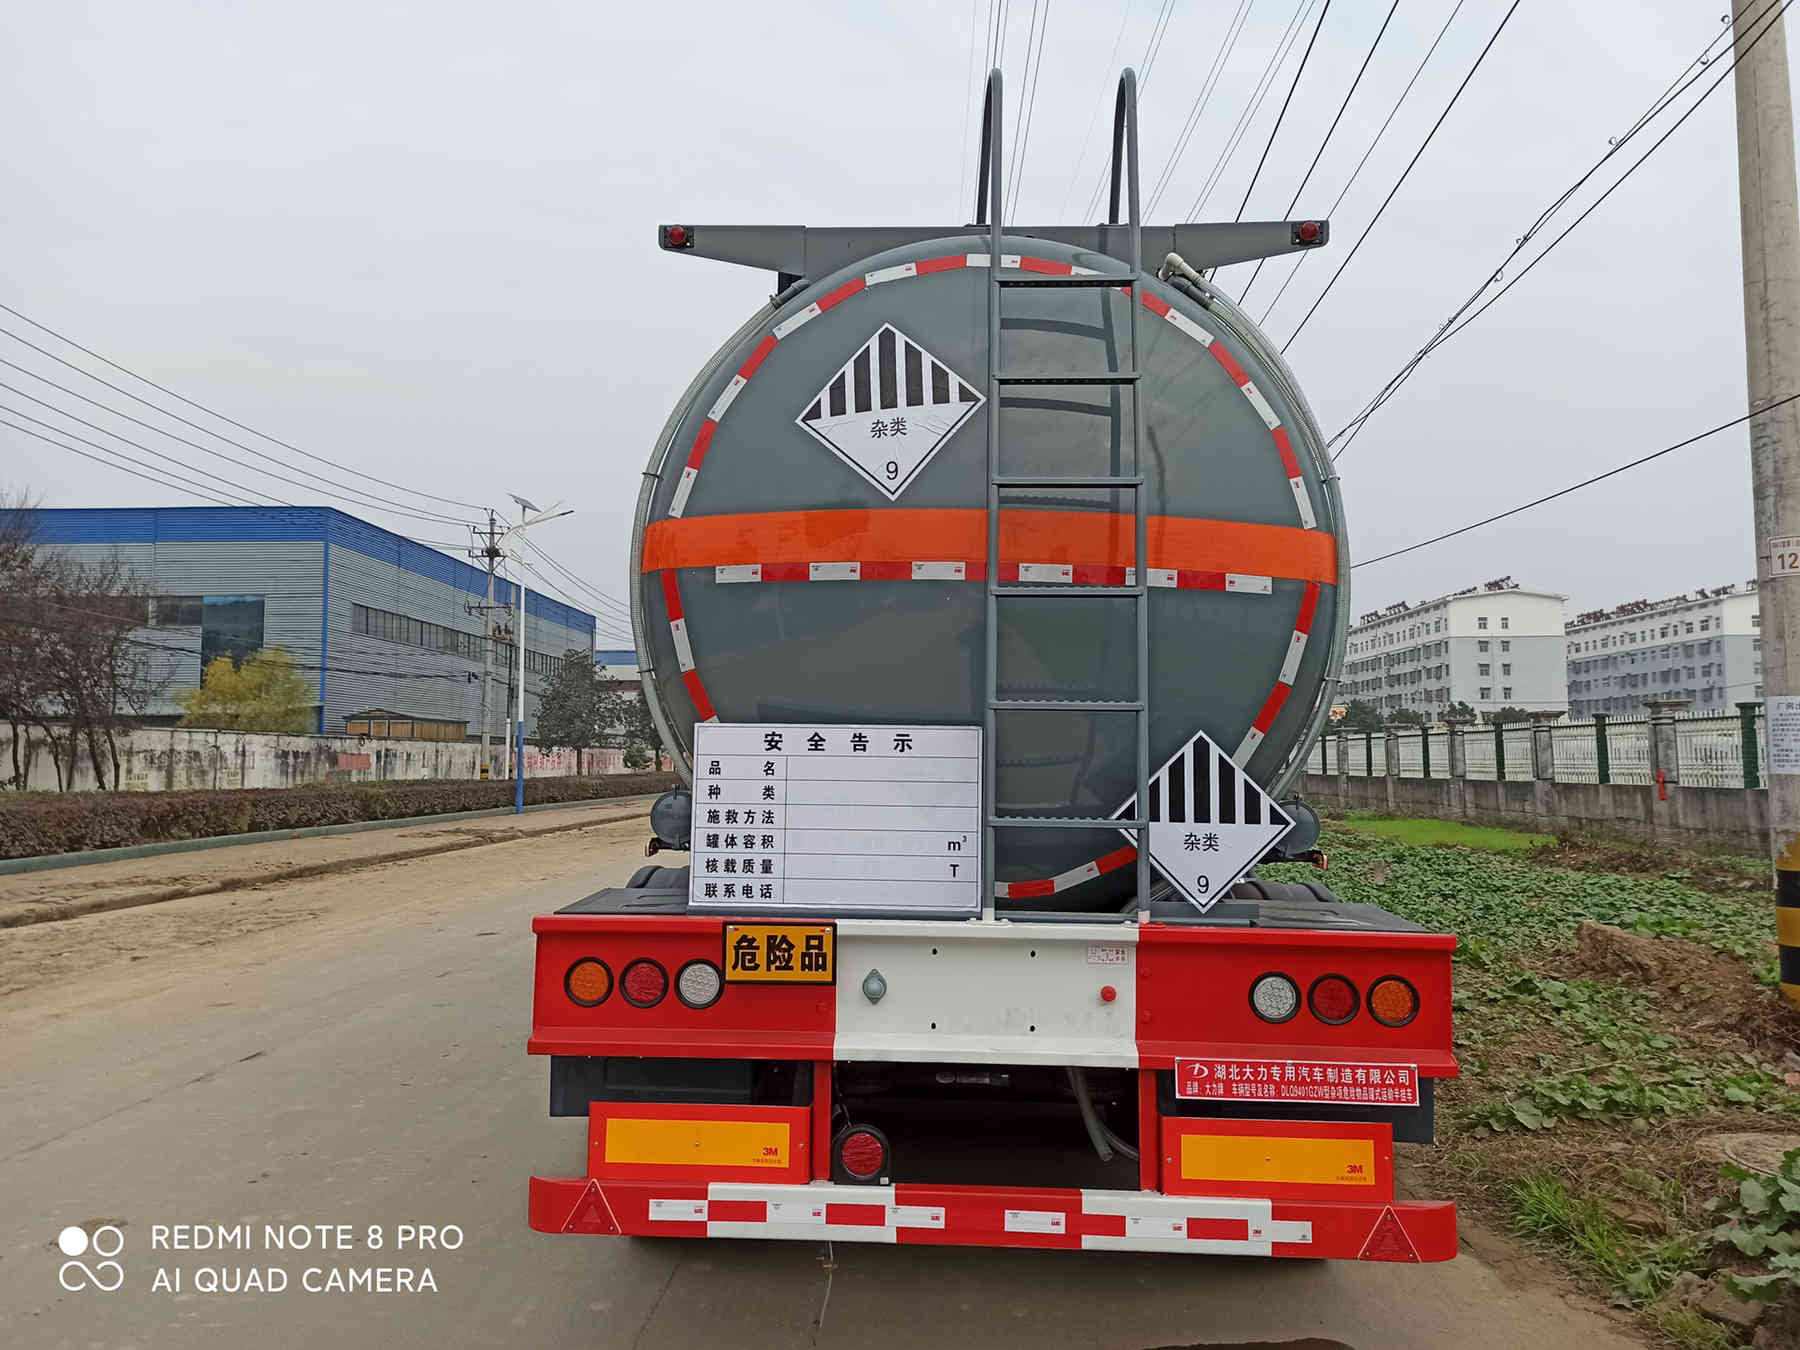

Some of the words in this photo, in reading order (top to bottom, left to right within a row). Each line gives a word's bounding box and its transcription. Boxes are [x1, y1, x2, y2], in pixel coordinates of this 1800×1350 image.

[870, 417, 908, 439] 杂类
[886, 461, 898, 480] 9
[764, 731, 913, 752] 安全告示
[706, 808, 775, 825] 施救方法
[706, 833, 775, 850] 罐体容积
[1184, 832, 1220, 852] 杂类
[705, 858, 774, 875] 核载质量
[949, 864, 960, 879] T
[704, 883, 773, 899] 联系电话
[1197, 875, 1210, 894] 9
[731, 934, 828, 972] 危险品
[1214, 1063, 1410, 1086] 湖北大力专用汽车制造有限公司
[762, 1147, 778, 1156] 3M
[1346, 1164, 1363, 1174] 3M
